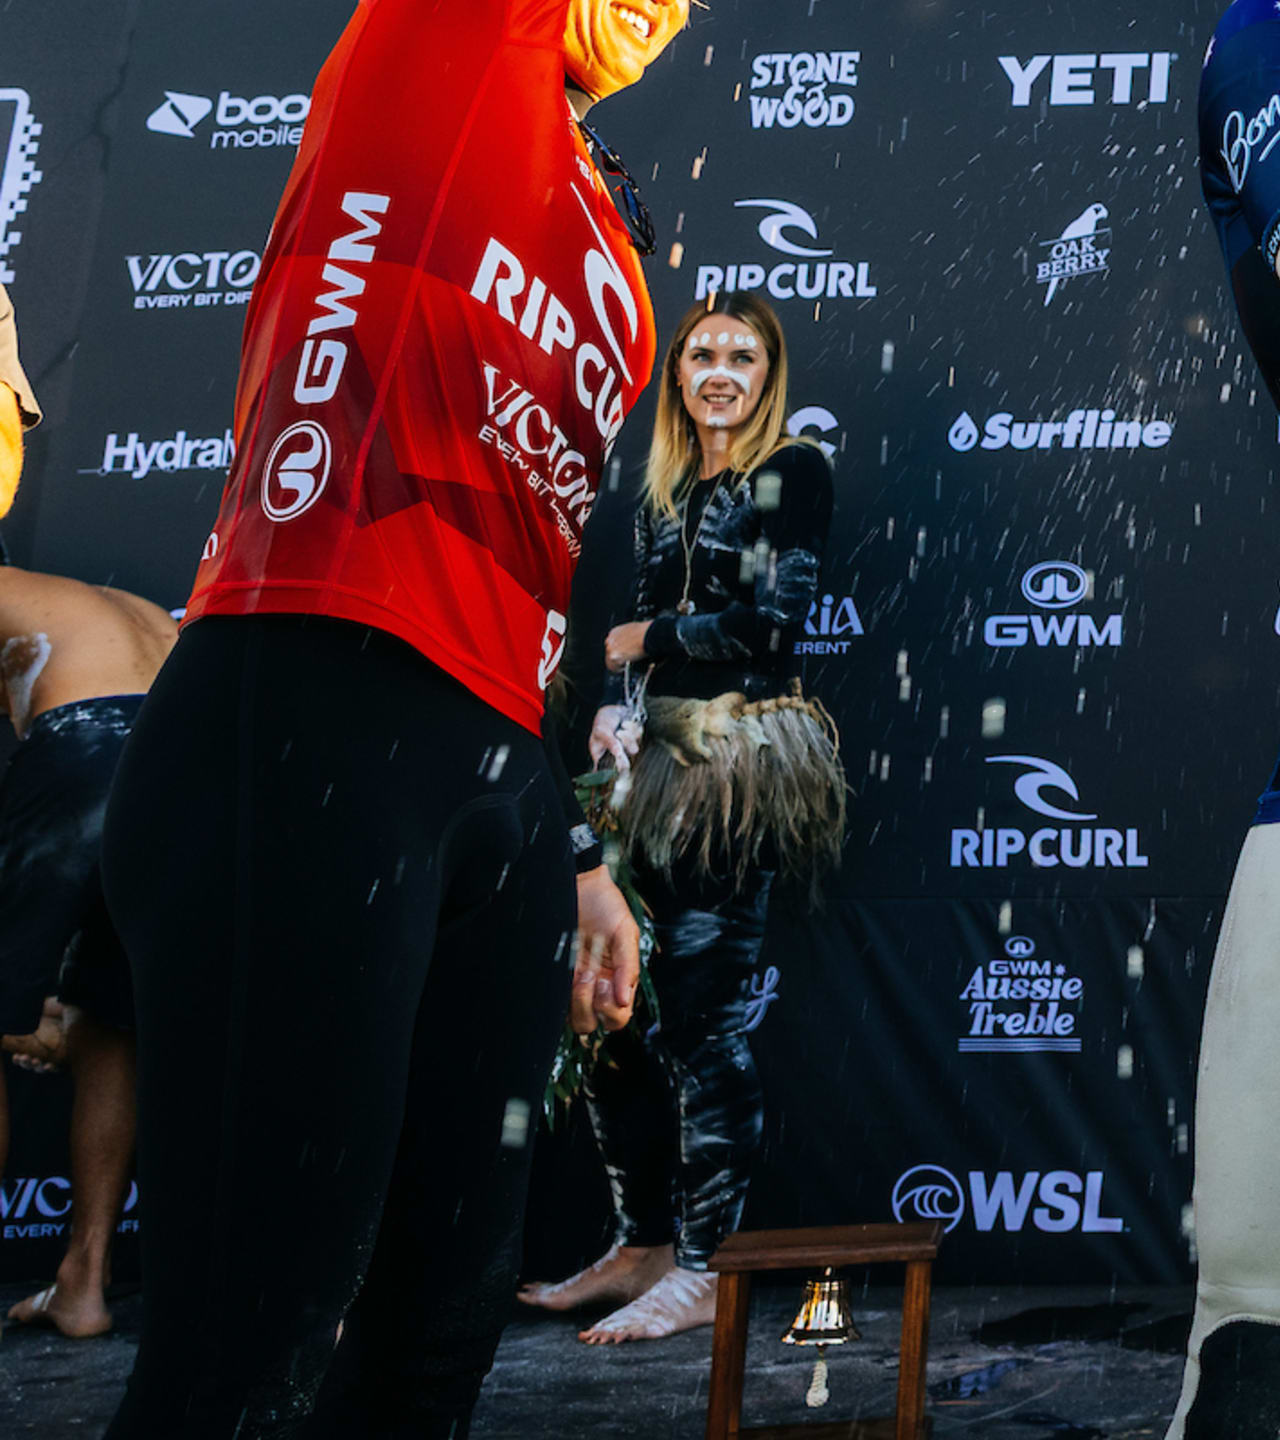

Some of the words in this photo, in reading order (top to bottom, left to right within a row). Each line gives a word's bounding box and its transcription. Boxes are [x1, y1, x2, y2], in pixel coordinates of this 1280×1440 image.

[751, 51, 861, 90] STONE
[999, 53, 1170, 106] YETI
[215, 91, 311, 124] boo
[1050, 234, 1096, 260] OAK
[127, 251, 260, 292] VICTO
[765, 263, 876, 298] CURL
[1036, 250, 1110, 280] BERRY
[134, 293, 190, 309] EVERY
[195, 293, 222, 307] BIT
[294, 191, 391, 405] GWM
[470, 236, 577, 357] RIP
[980, 410, 1172, 450] Surfline
[984, 614, 1122, 647] GWM
[950, 829, 1027, 867] RIP
[1028, 828, 1148, 867] CURL
[960, 966, 1083, 1001] Aussie
[989, 961, 1050, 976] GWM
[969, 1002, 1075, 1037] Treble
[968, 1172, 1122, 1233] WSL
